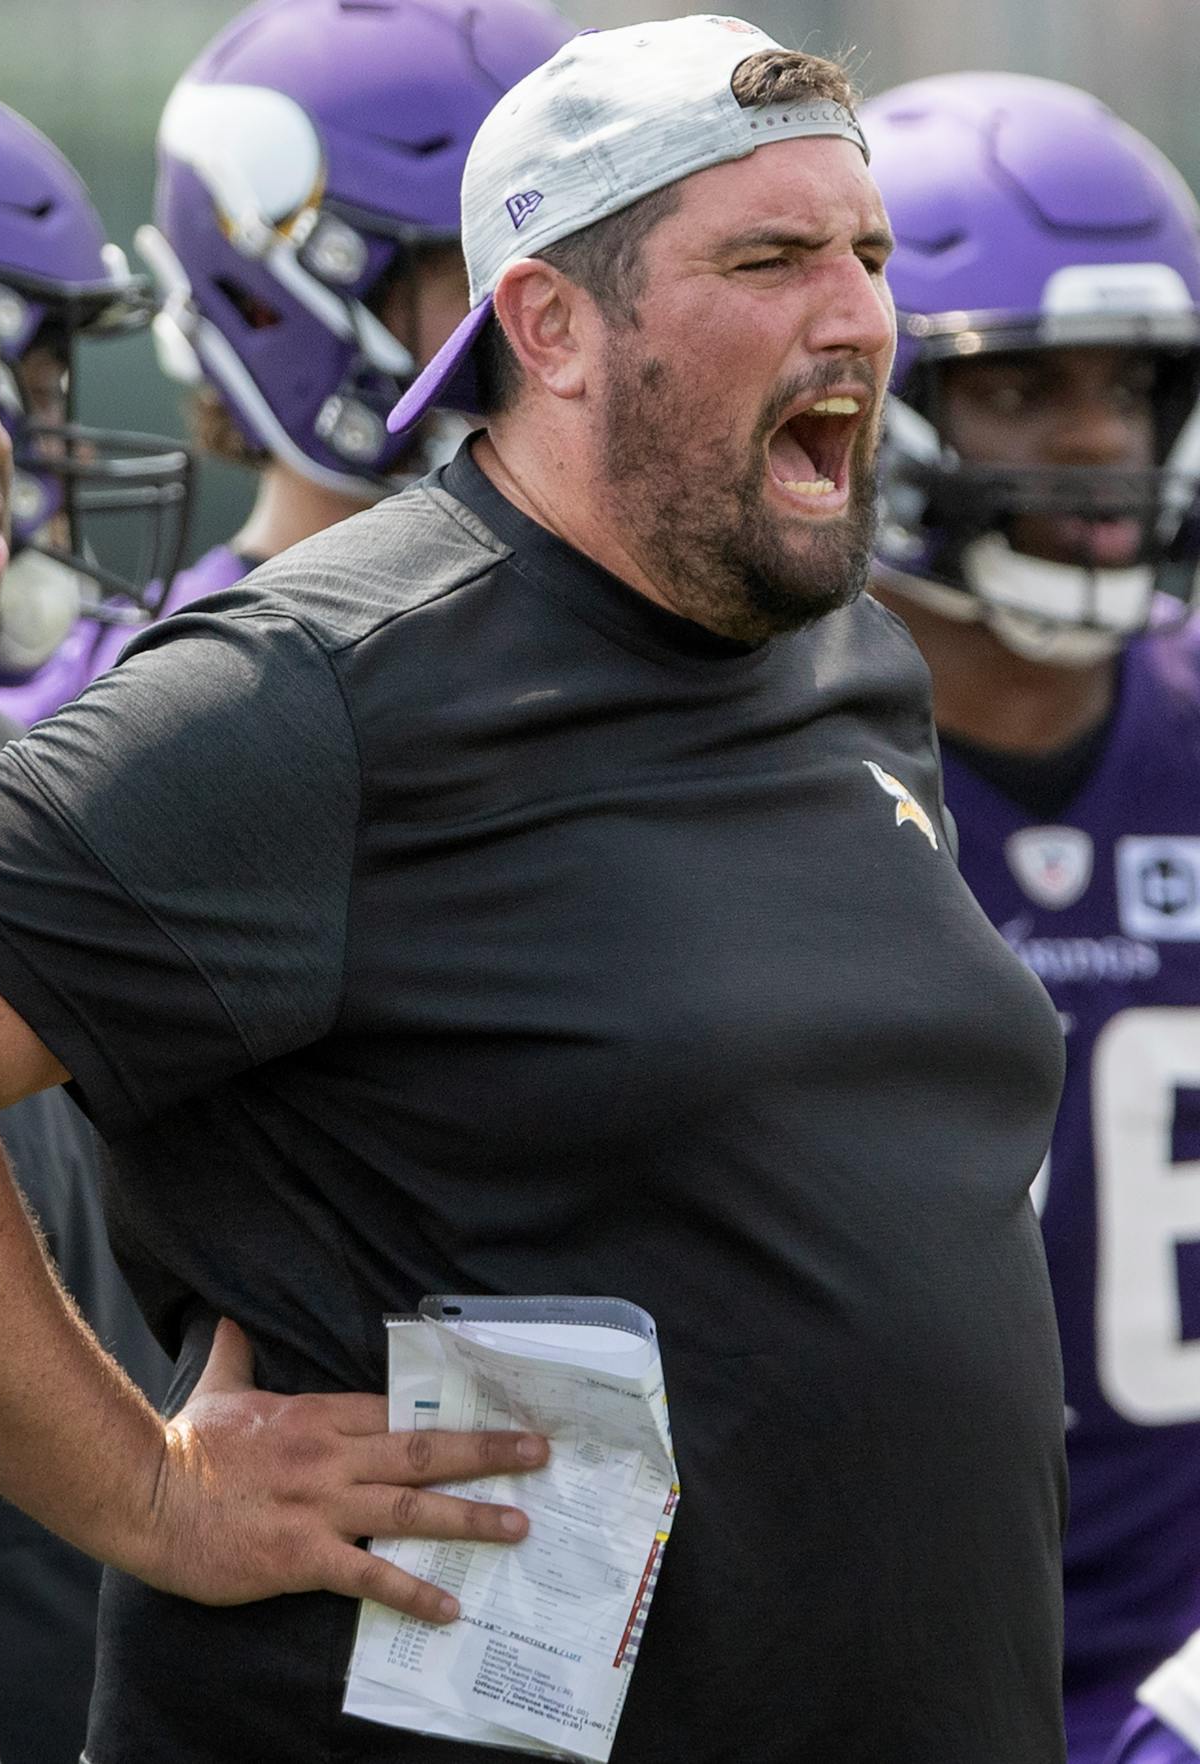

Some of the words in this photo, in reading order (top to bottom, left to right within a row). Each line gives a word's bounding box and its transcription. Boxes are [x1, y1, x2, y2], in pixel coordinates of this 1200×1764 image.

[508, 1631, 546, 1649] PRACTICE
[485, 1644, 518, 1660] Breakfast
[472, 1686, 500, 1700] Special
[501, 1696, 525, 1709] Teams
[474, 1679, 504, 1694] Offense
[512, 1693, 541, 1707] Defense
